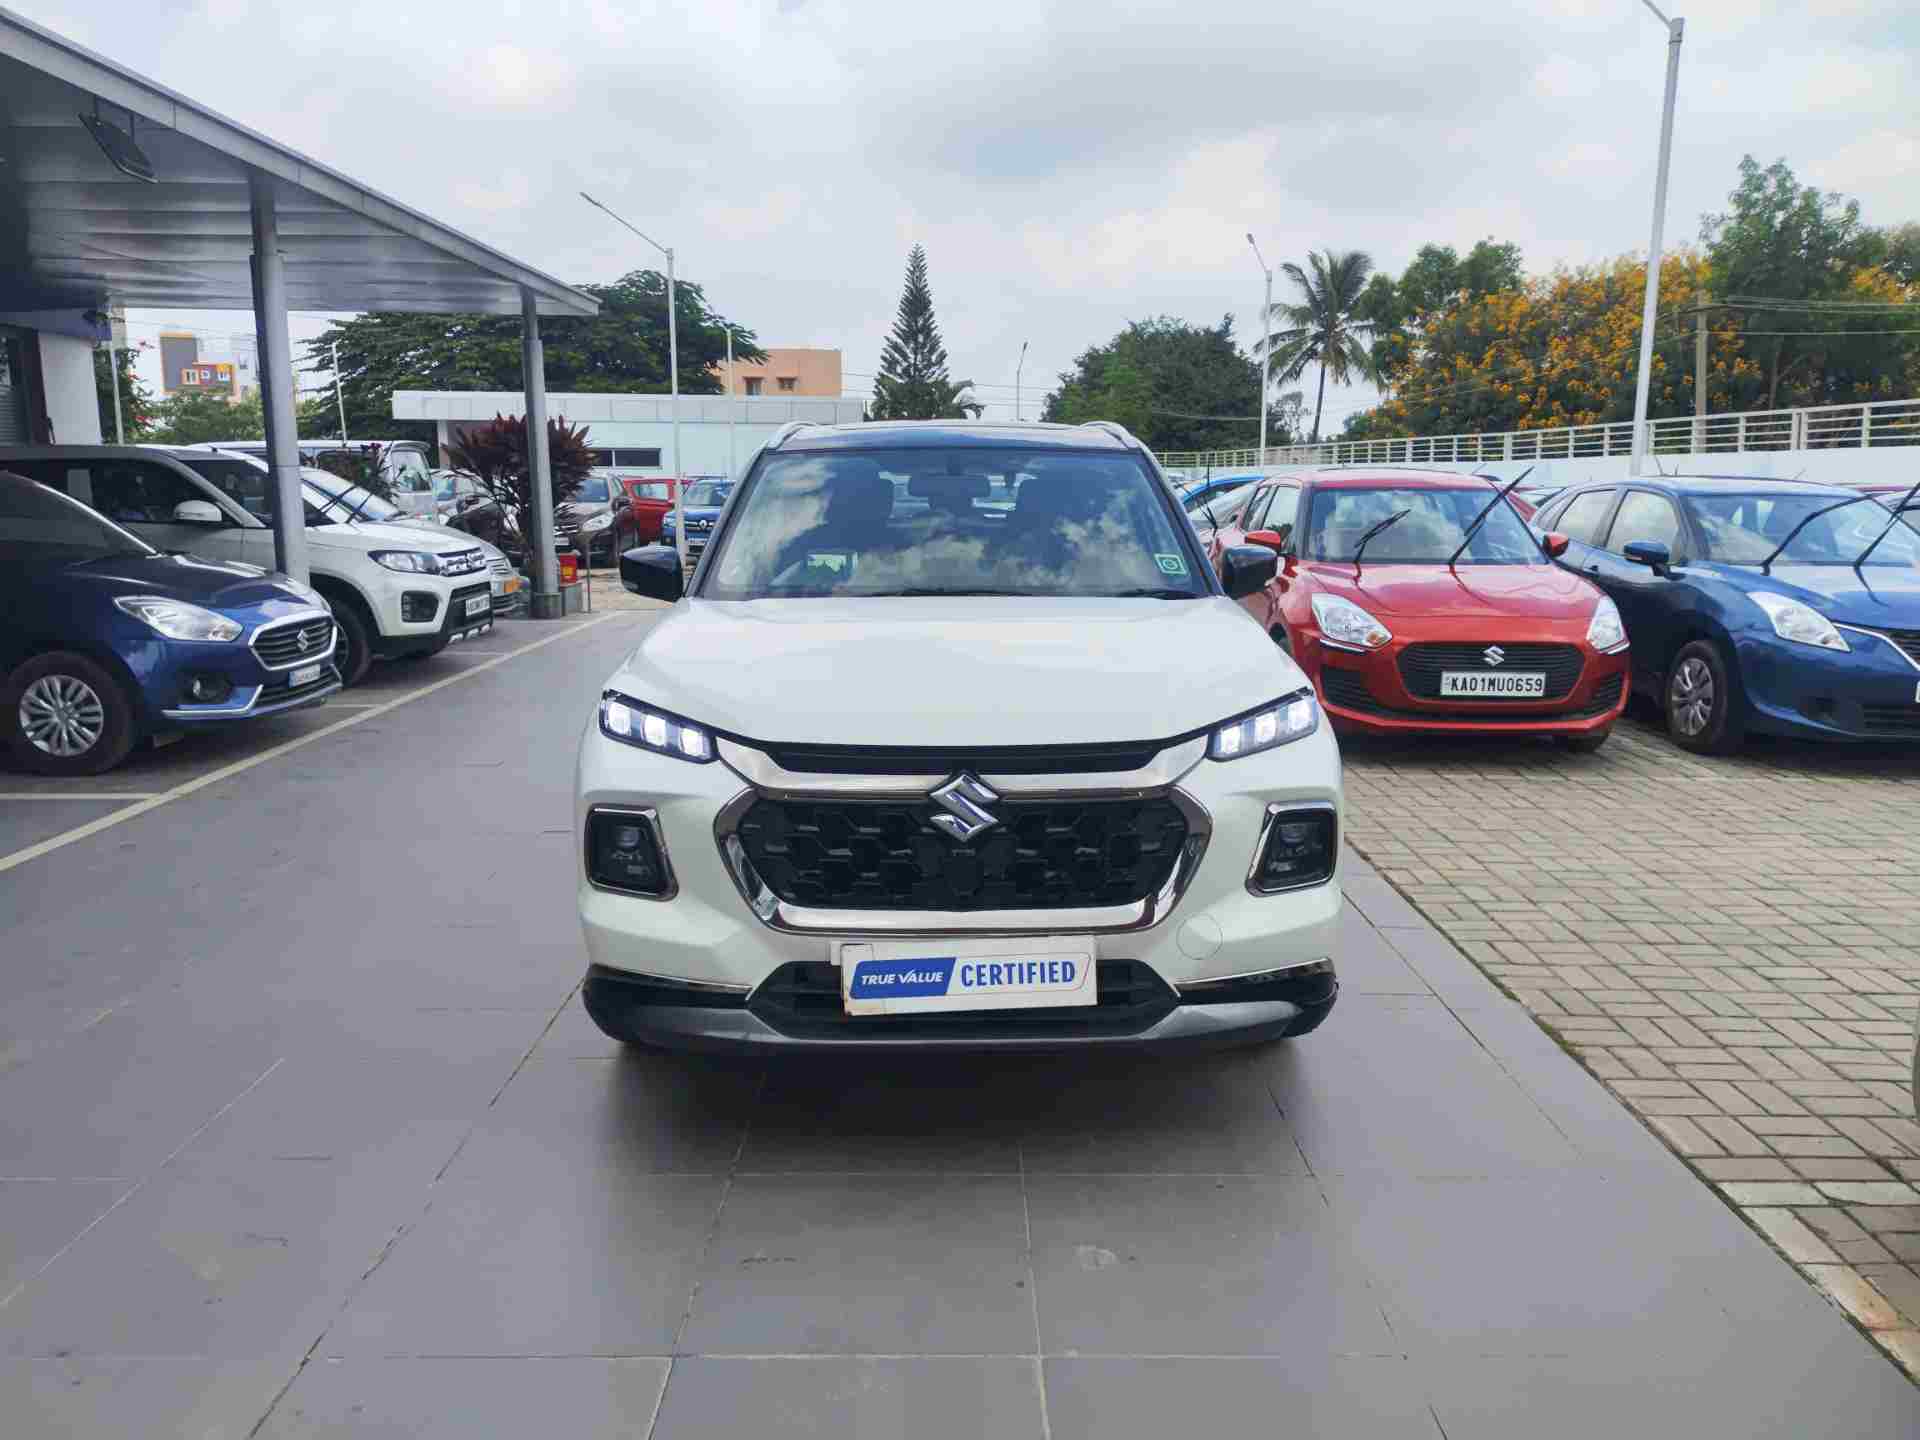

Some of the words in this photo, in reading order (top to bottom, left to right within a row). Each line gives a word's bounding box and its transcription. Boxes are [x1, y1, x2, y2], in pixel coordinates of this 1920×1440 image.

[1451, 677, 1543, 692] KA01MU0659
[861, 974, 896, 985] TRUE
[898, 969, 944, 984] VALUE
[961, 961, 1075, 987] CERTIFIED
